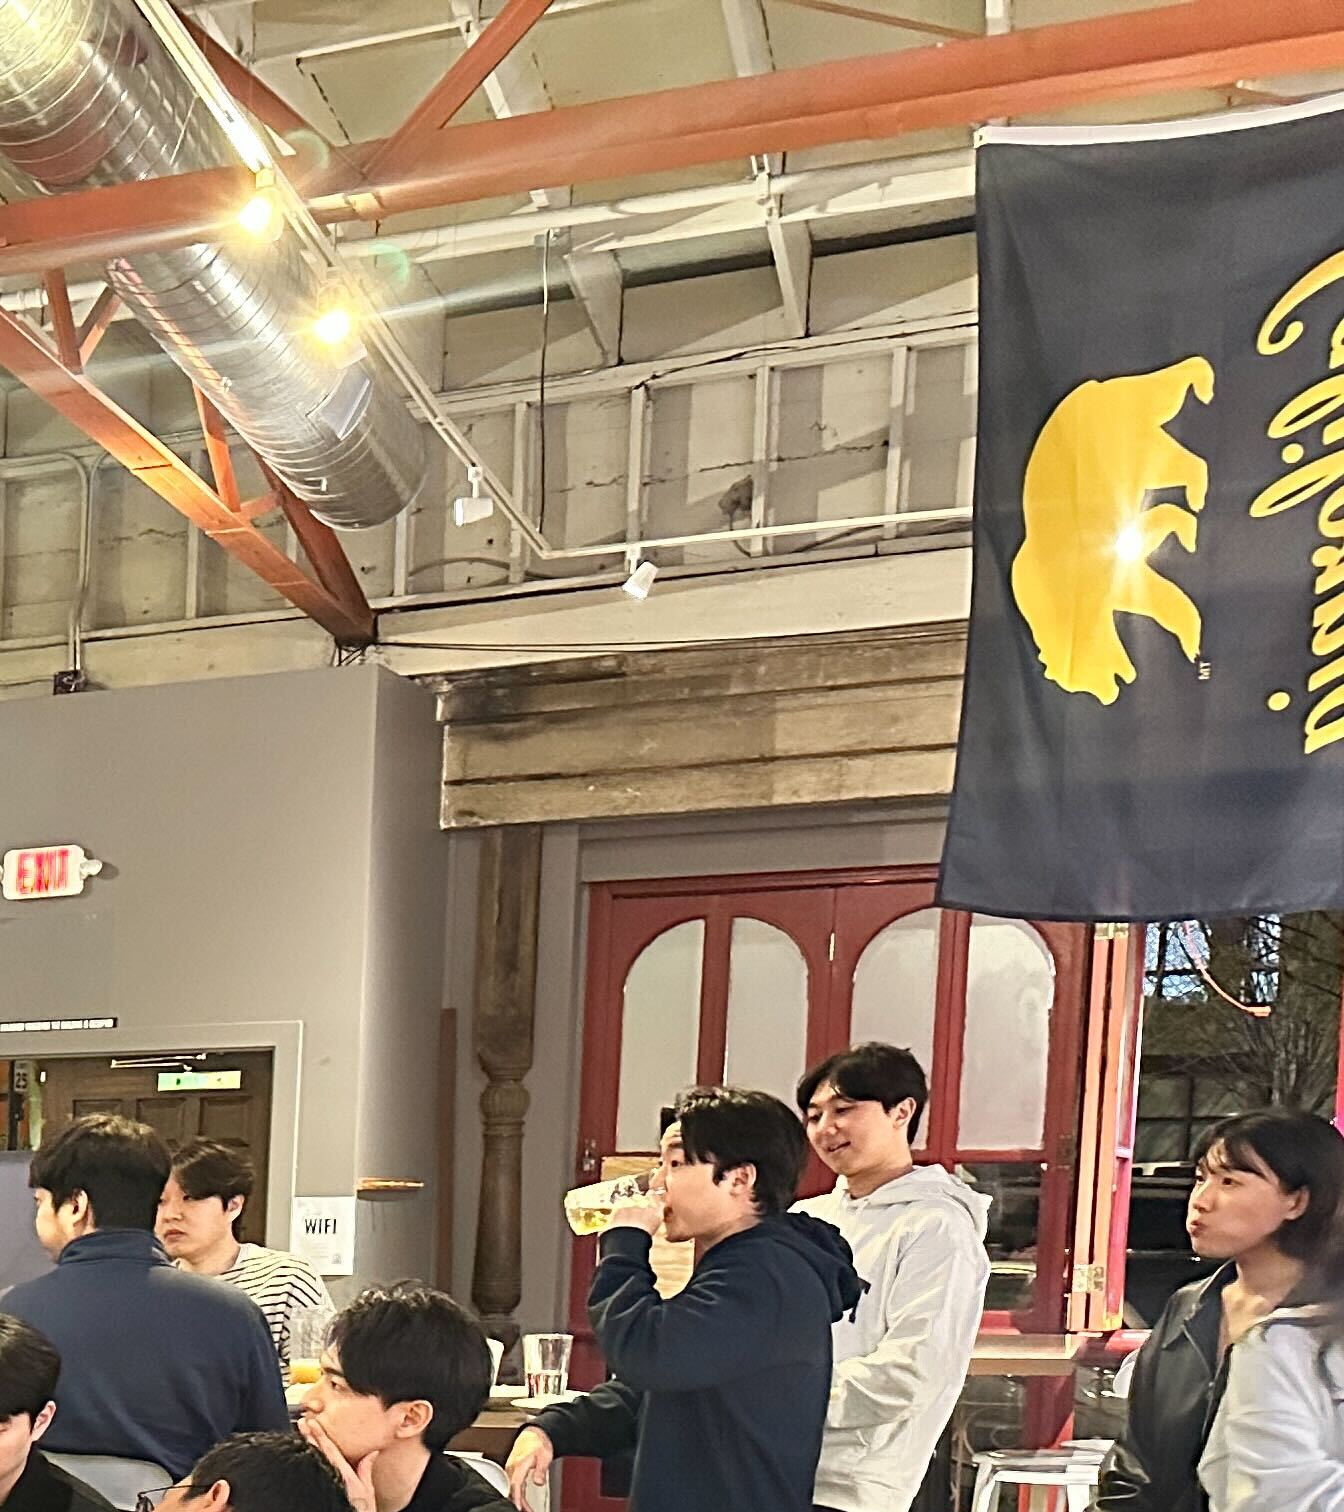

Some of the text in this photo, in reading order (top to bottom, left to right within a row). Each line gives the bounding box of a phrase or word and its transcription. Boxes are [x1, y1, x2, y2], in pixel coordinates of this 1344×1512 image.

[16, 849, 69, 895] EXIT
[15, 1071, 27, 1089] 25
[305, 1218, 337, 1235] WIFI
